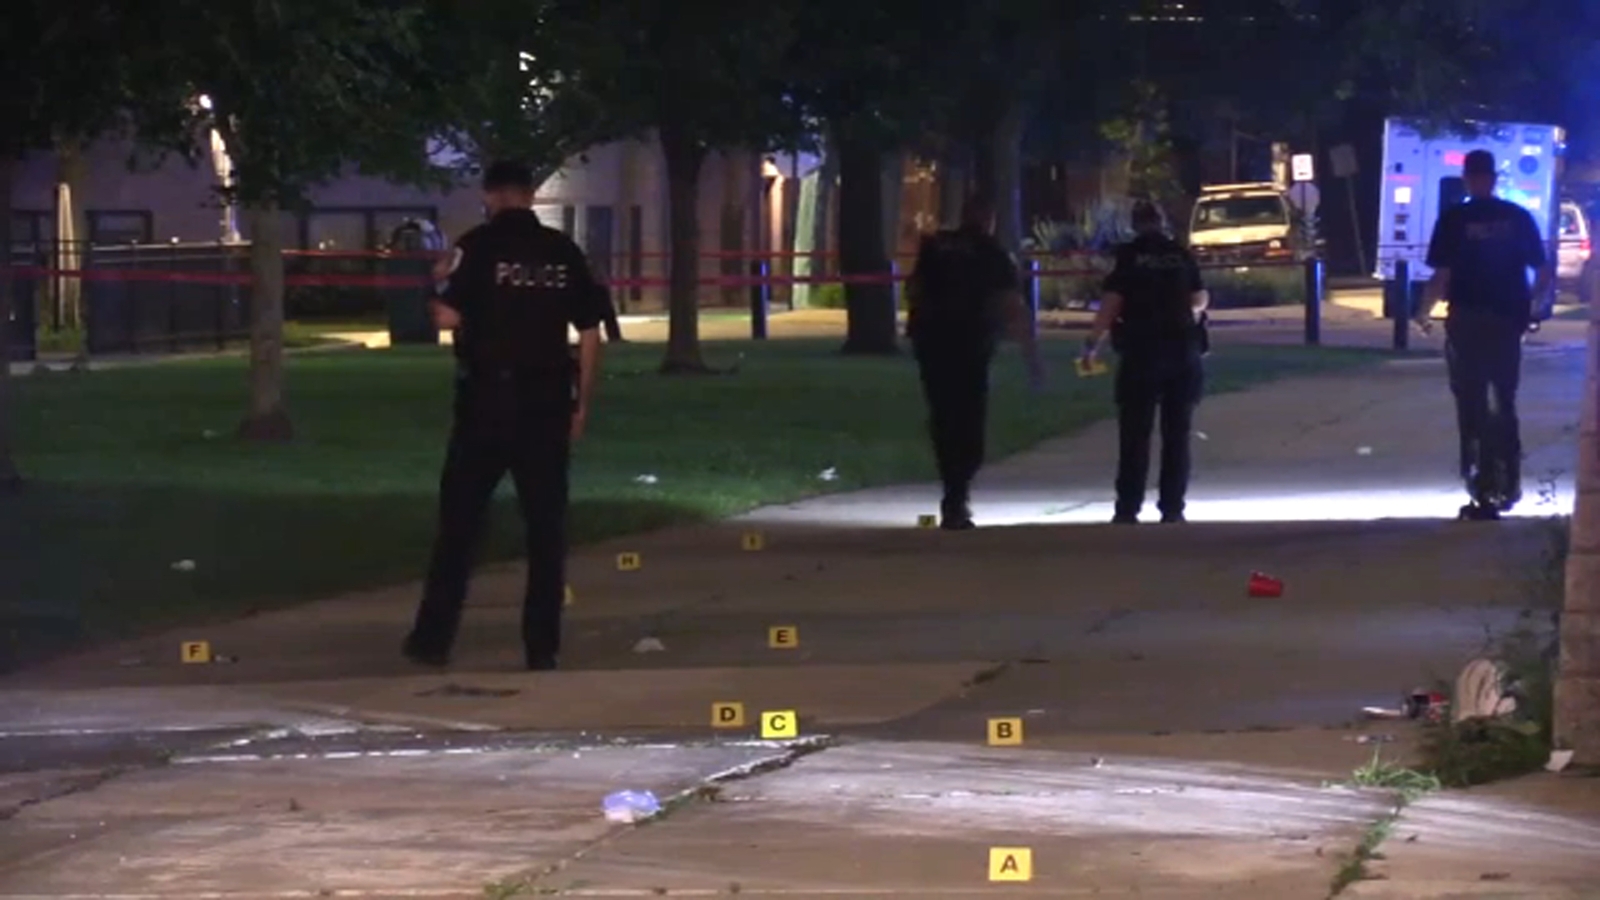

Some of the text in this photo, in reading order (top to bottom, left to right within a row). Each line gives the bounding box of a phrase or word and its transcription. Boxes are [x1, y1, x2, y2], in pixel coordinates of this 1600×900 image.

[496, 262, 567, 288] POLICE
[621, 555, 634, 566] H
[776, 629, 789, 643] E
[189, 644, 201, 658] F
[720, 707, 736, 722] D
[769, 714, 786, 731] C
[997, 721, 1013, 739] B
[999, 854, 1020, 874] A
